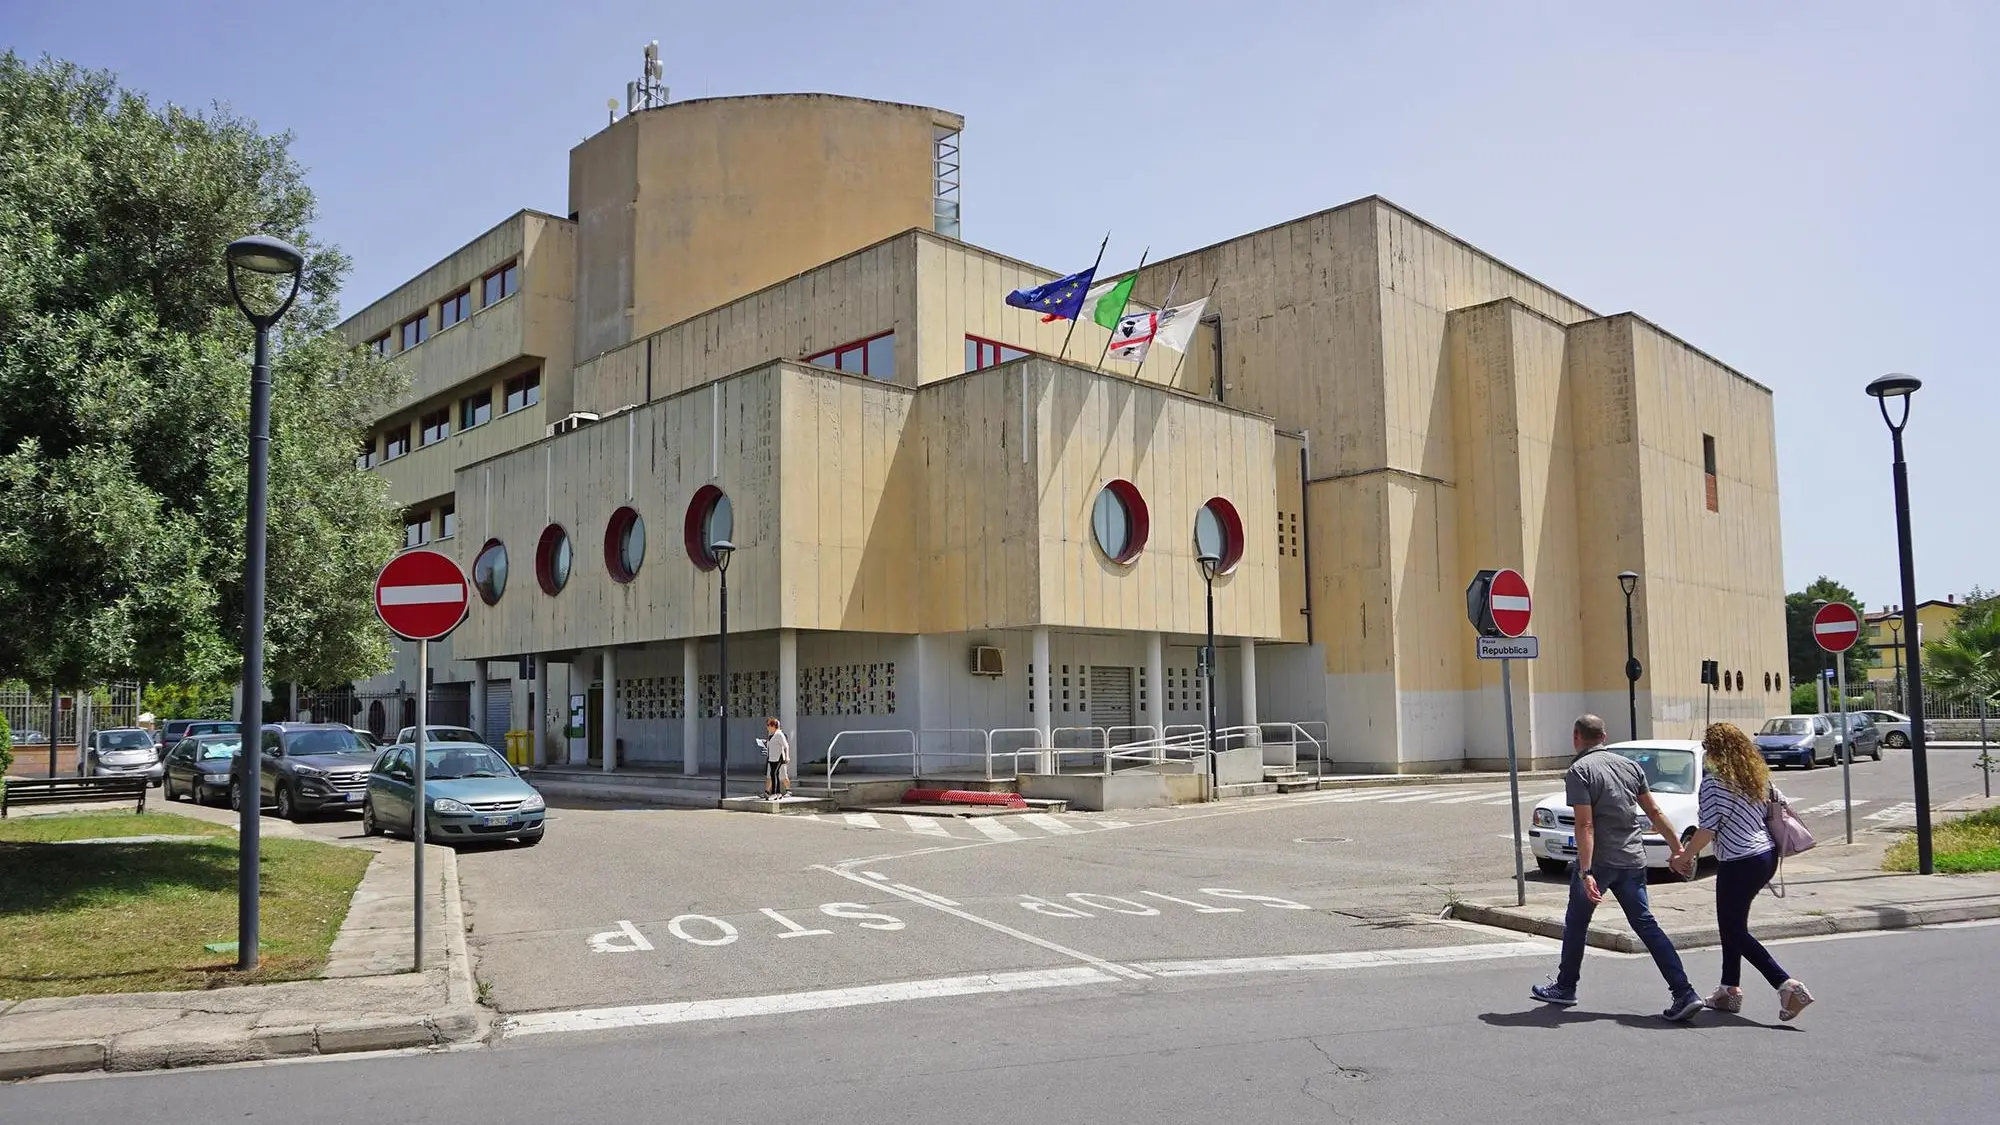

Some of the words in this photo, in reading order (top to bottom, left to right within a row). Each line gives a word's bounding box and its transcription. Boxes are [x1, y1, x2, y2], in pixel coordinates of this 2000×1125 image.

[1482, 646, 1528, 655] Repubblica
[1016, 888, 1311, 918] STOP
[585, 902, 905, 953] STOP
